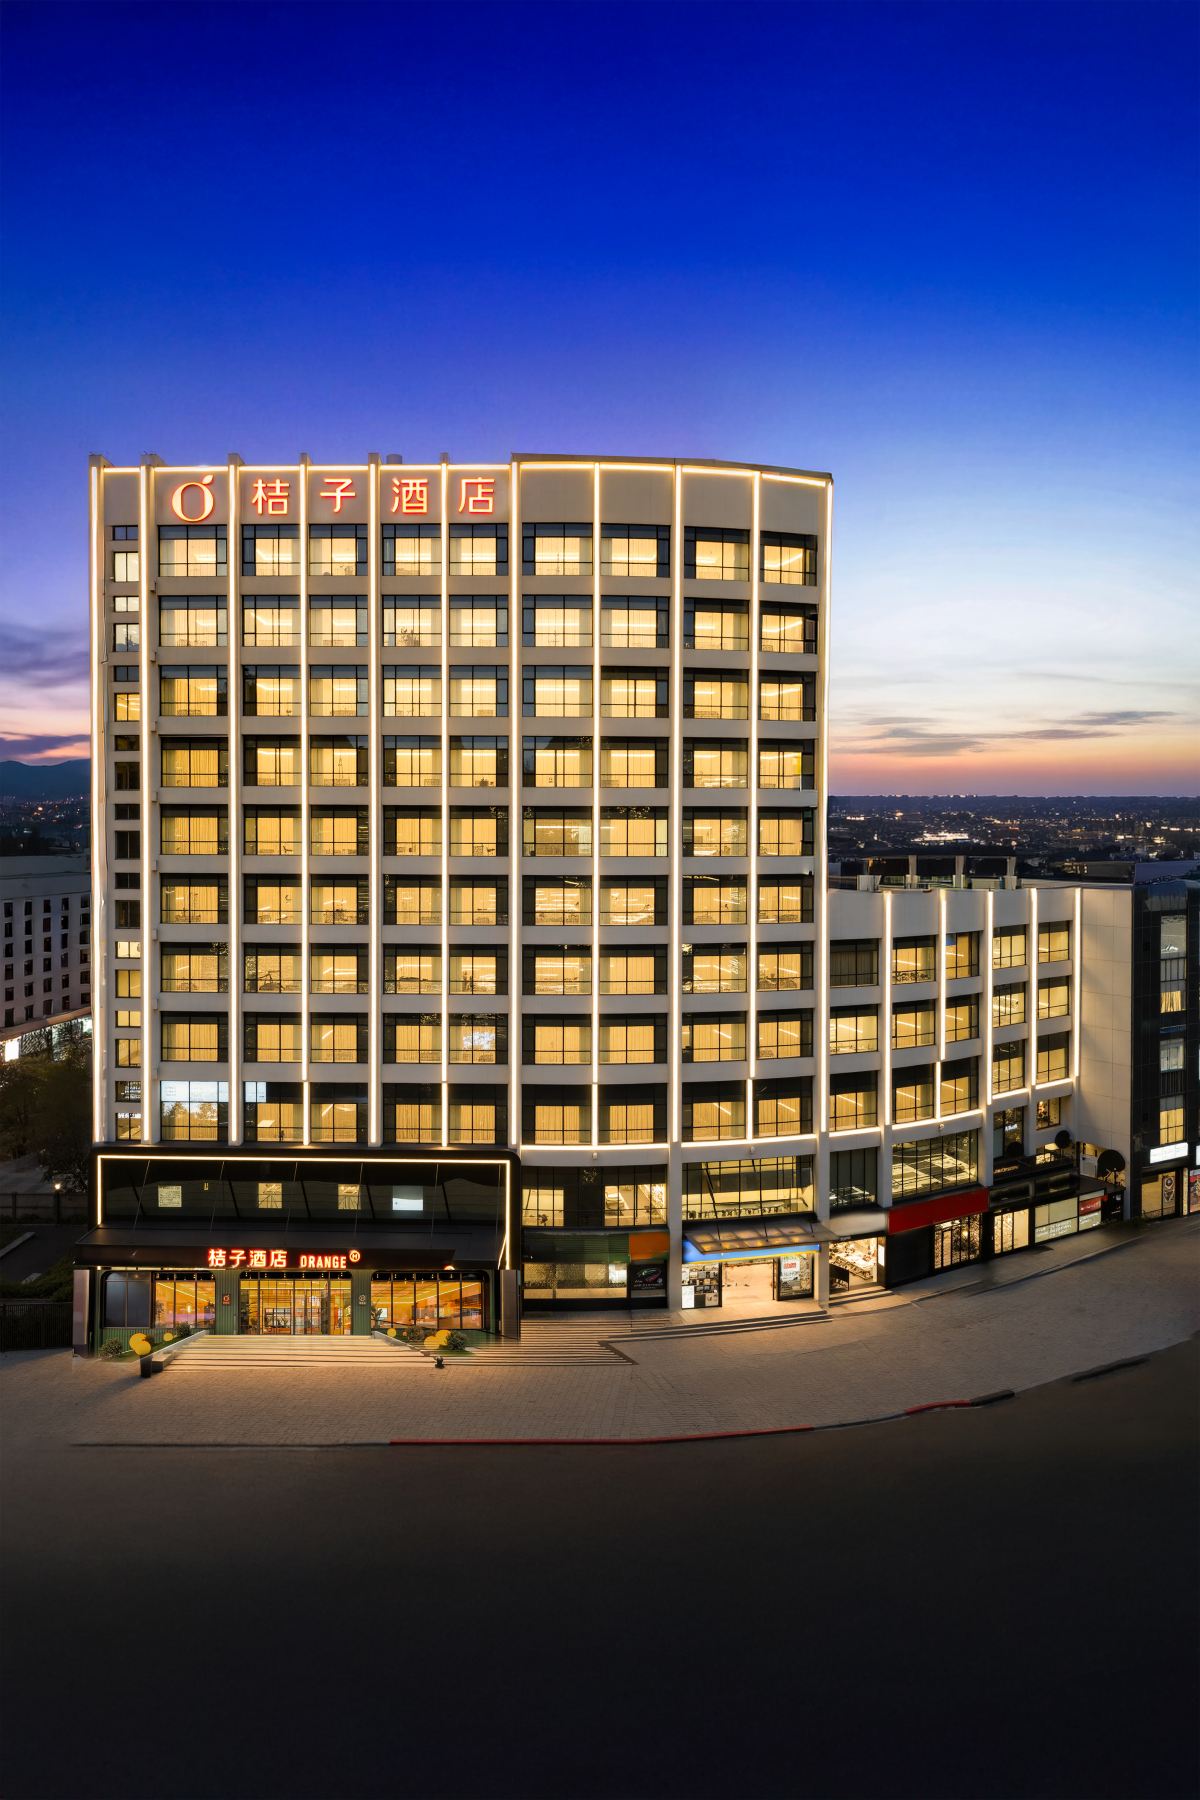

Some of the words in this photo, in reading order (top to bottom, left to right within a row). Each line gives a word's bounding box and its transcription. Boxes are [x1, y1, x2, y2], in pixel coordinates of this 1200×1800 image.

[251, 477, 495, 514] 桔子酒店
[208, 1249, 287, 1268] 桔子酒店
[300, 1255, 347, 1269] ORANGE
